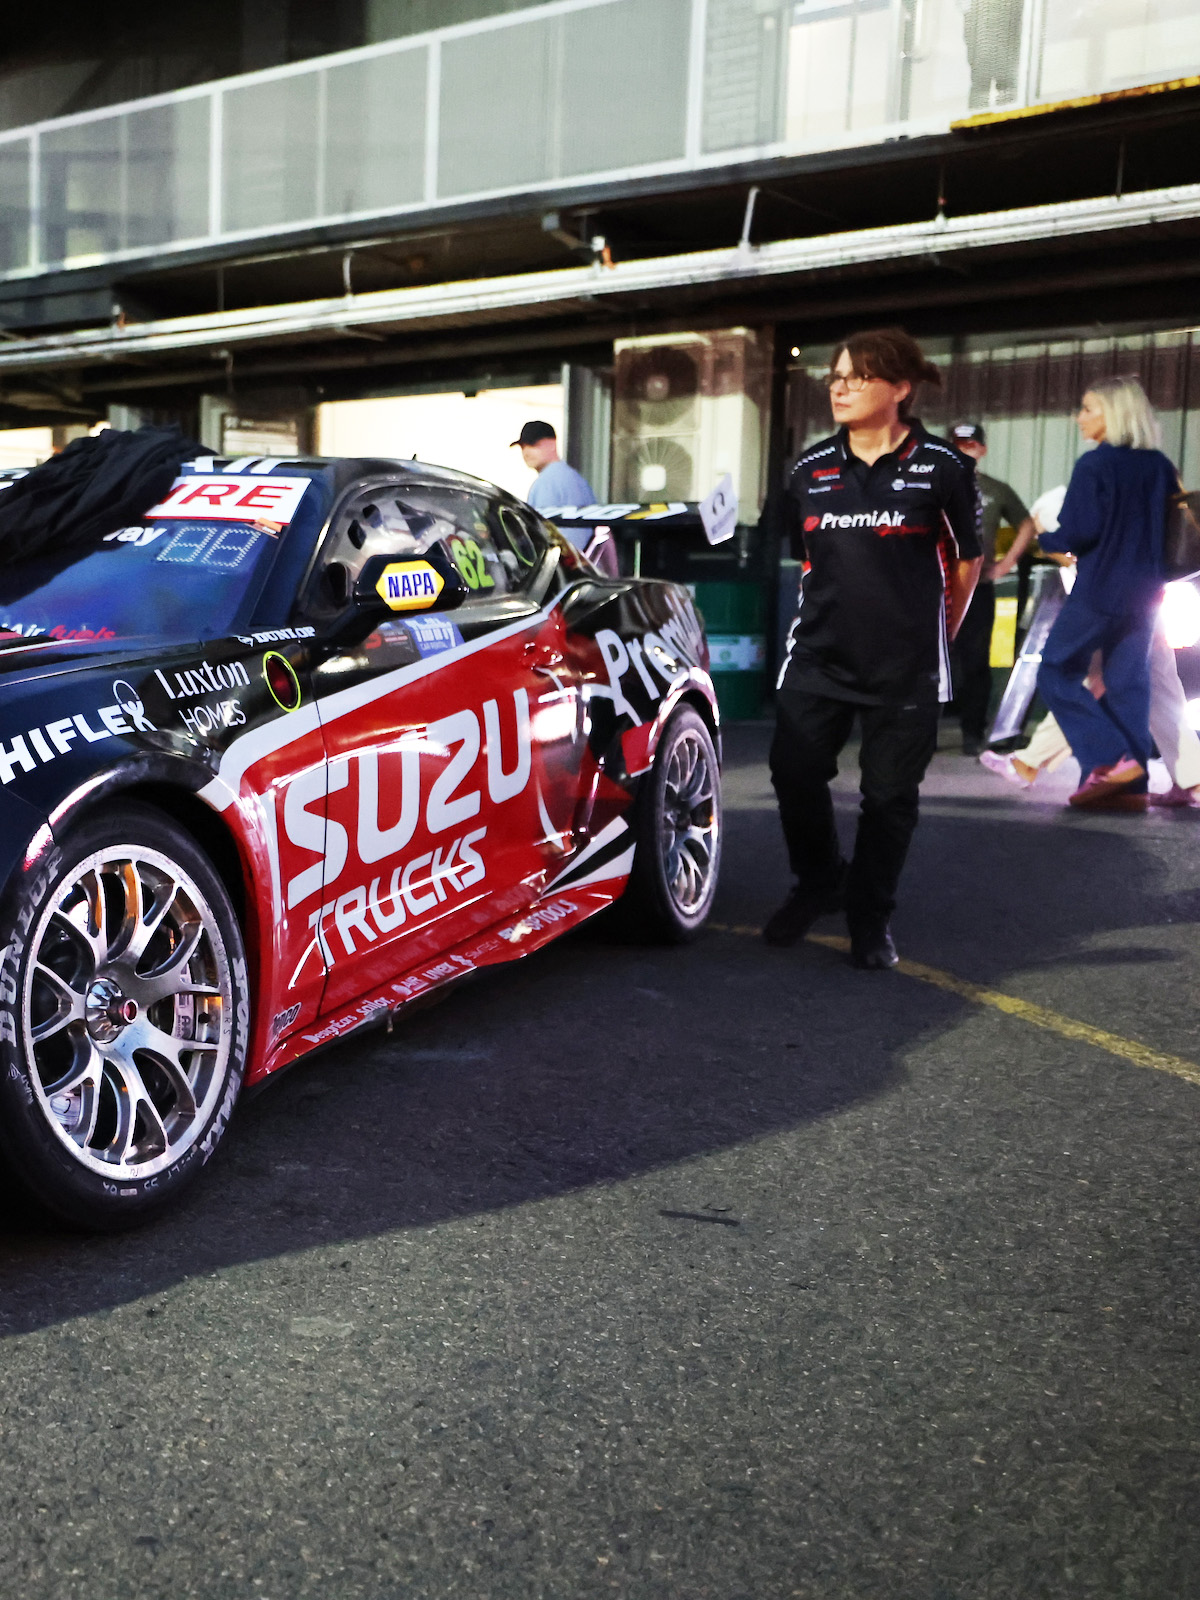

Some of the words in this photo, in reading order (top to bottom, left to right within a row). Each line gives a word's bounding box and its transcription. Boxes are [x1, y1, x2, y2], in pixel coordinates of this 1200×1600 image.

[820, 510, 905, 530] PremiAir
[451, 539, 495, 590] 62
[388, 572, 435, 599] NAPA
[49, 624, 116, 640] fuels
[251, 626, 316, 645] DUNLOP
[154, 661, 250, 699] Luxton
[179, 699, 246, 735] HOMES
[308, 826, 487, 966] TRUCKS
[232, 957, 249, 1072] SPORT
